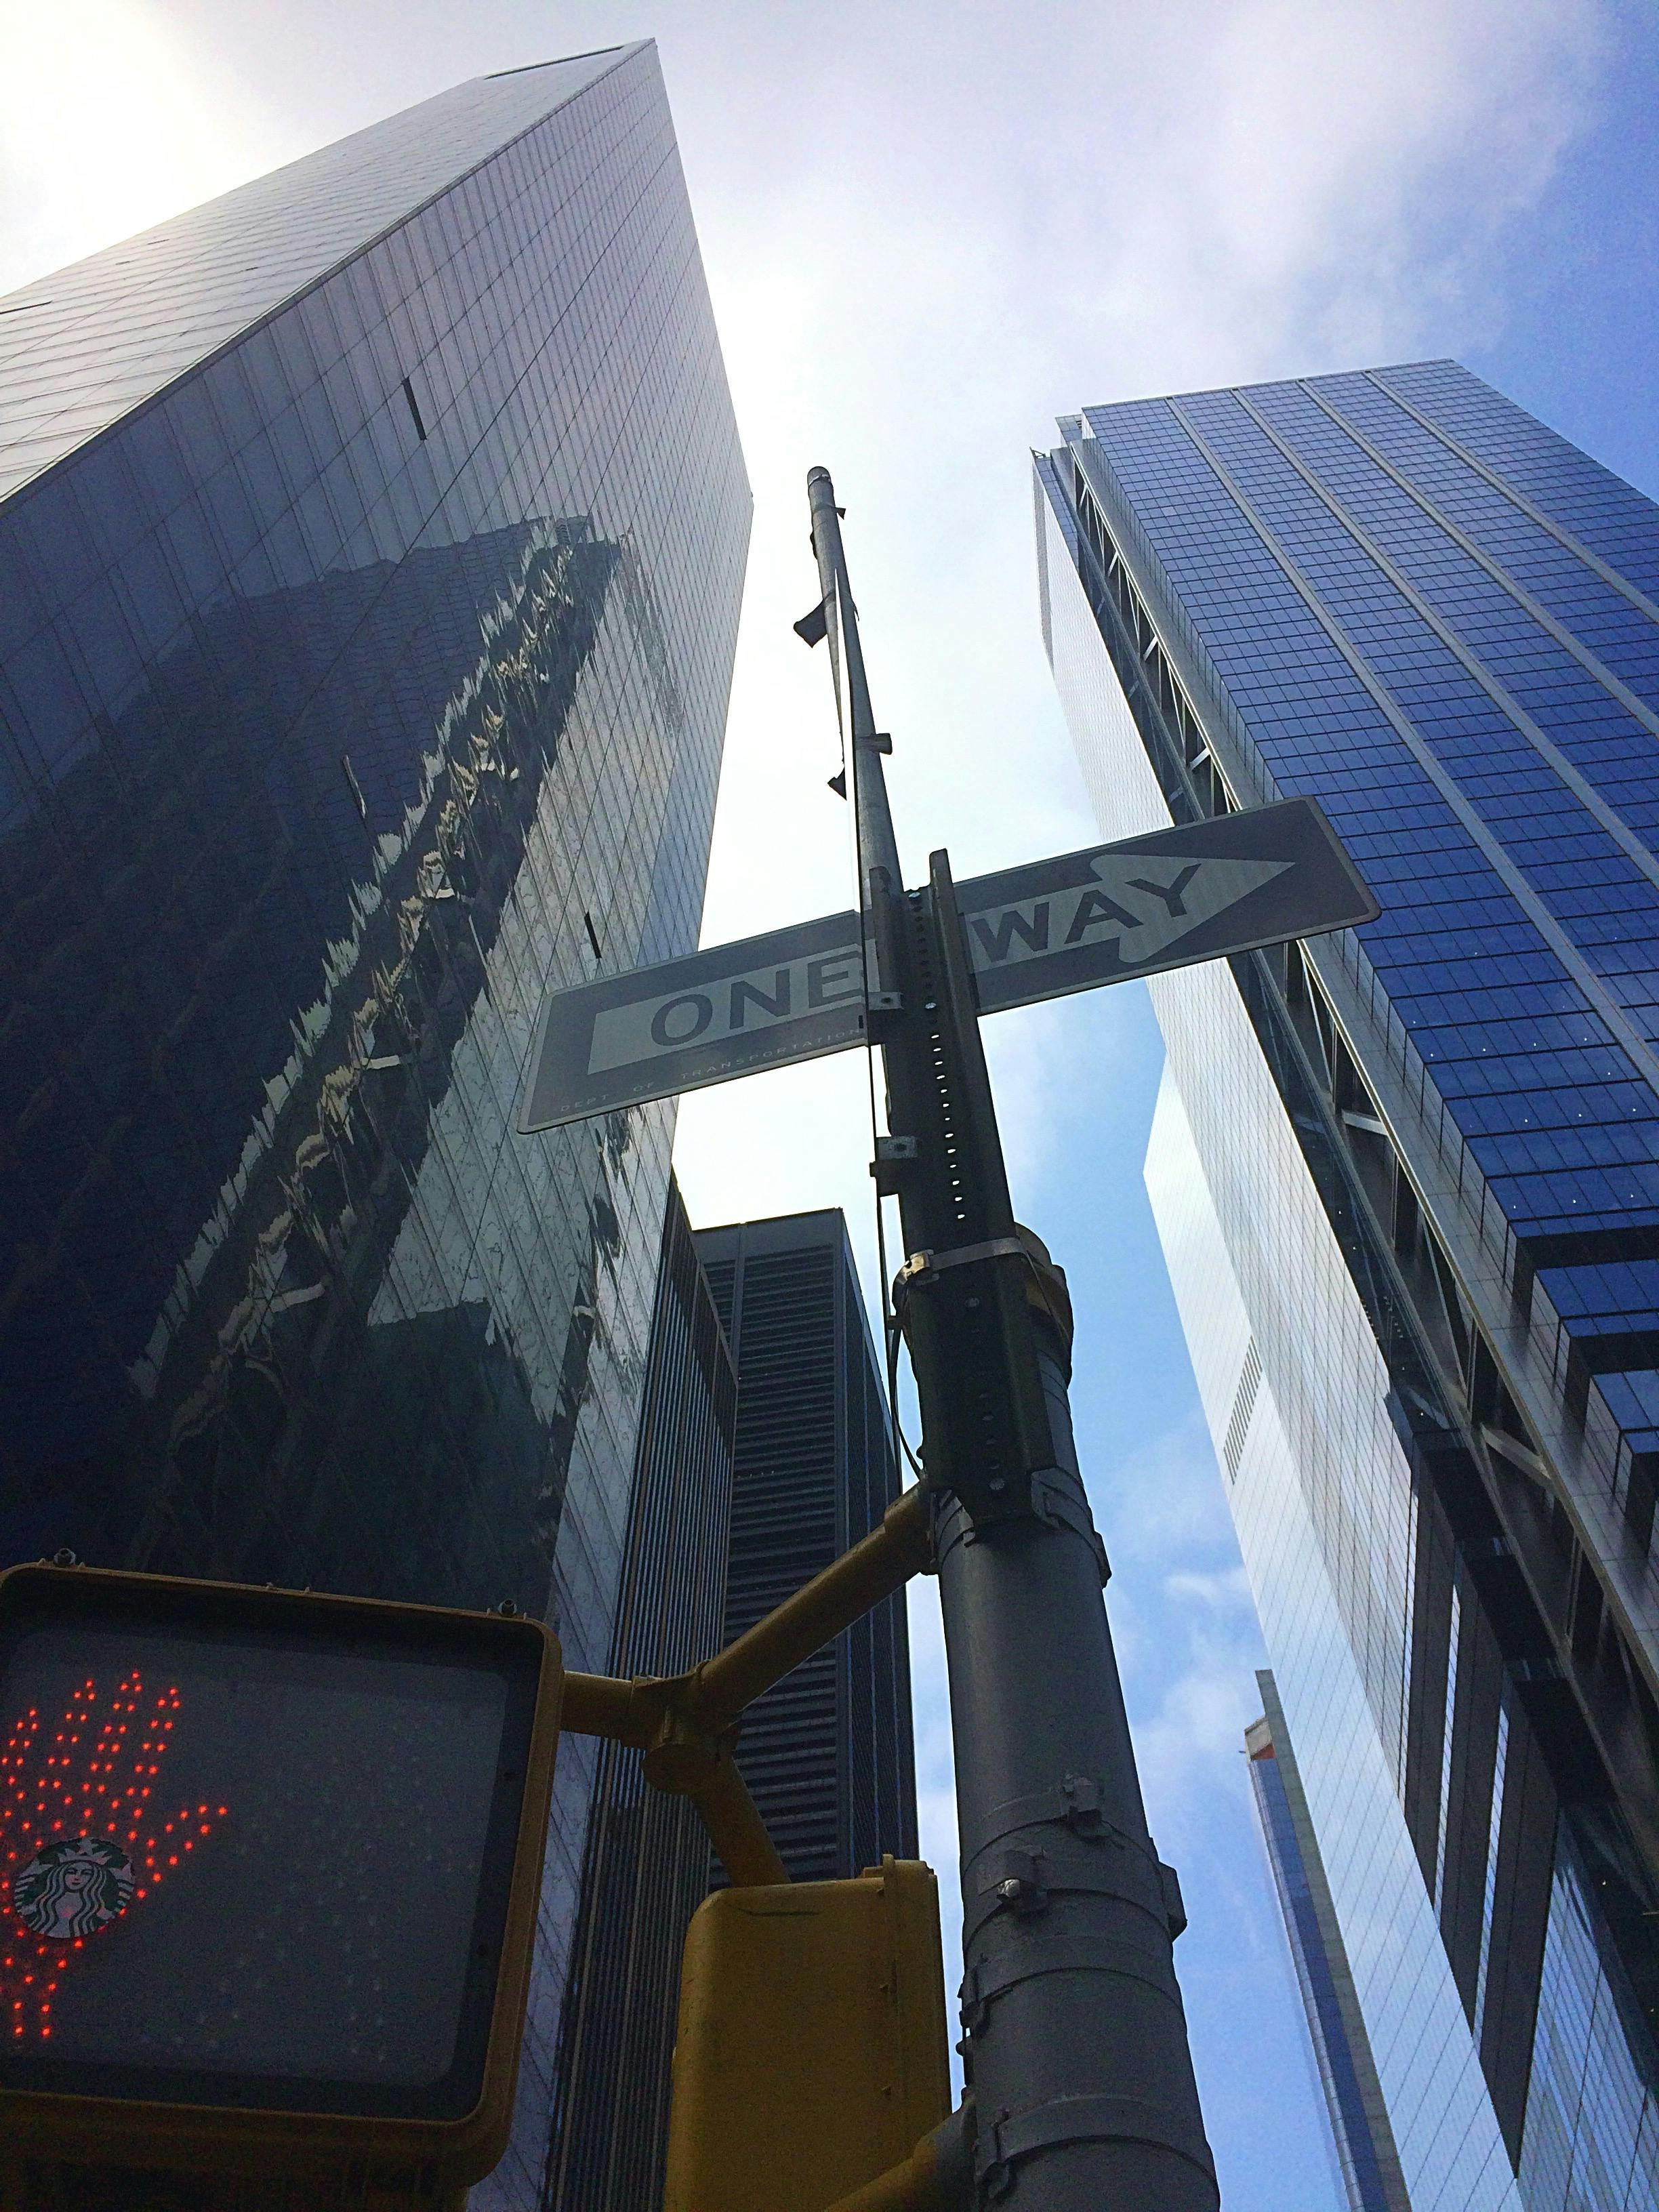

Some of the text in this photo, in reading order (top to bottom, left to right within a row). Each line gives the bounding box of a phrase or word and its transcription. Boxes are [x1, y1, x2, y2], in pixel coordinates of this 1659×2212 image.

[651, 863, 1202, 1046] ONE WAY
[560, 1028, 860, 1112] DEPT OF TRANSPORTATION
